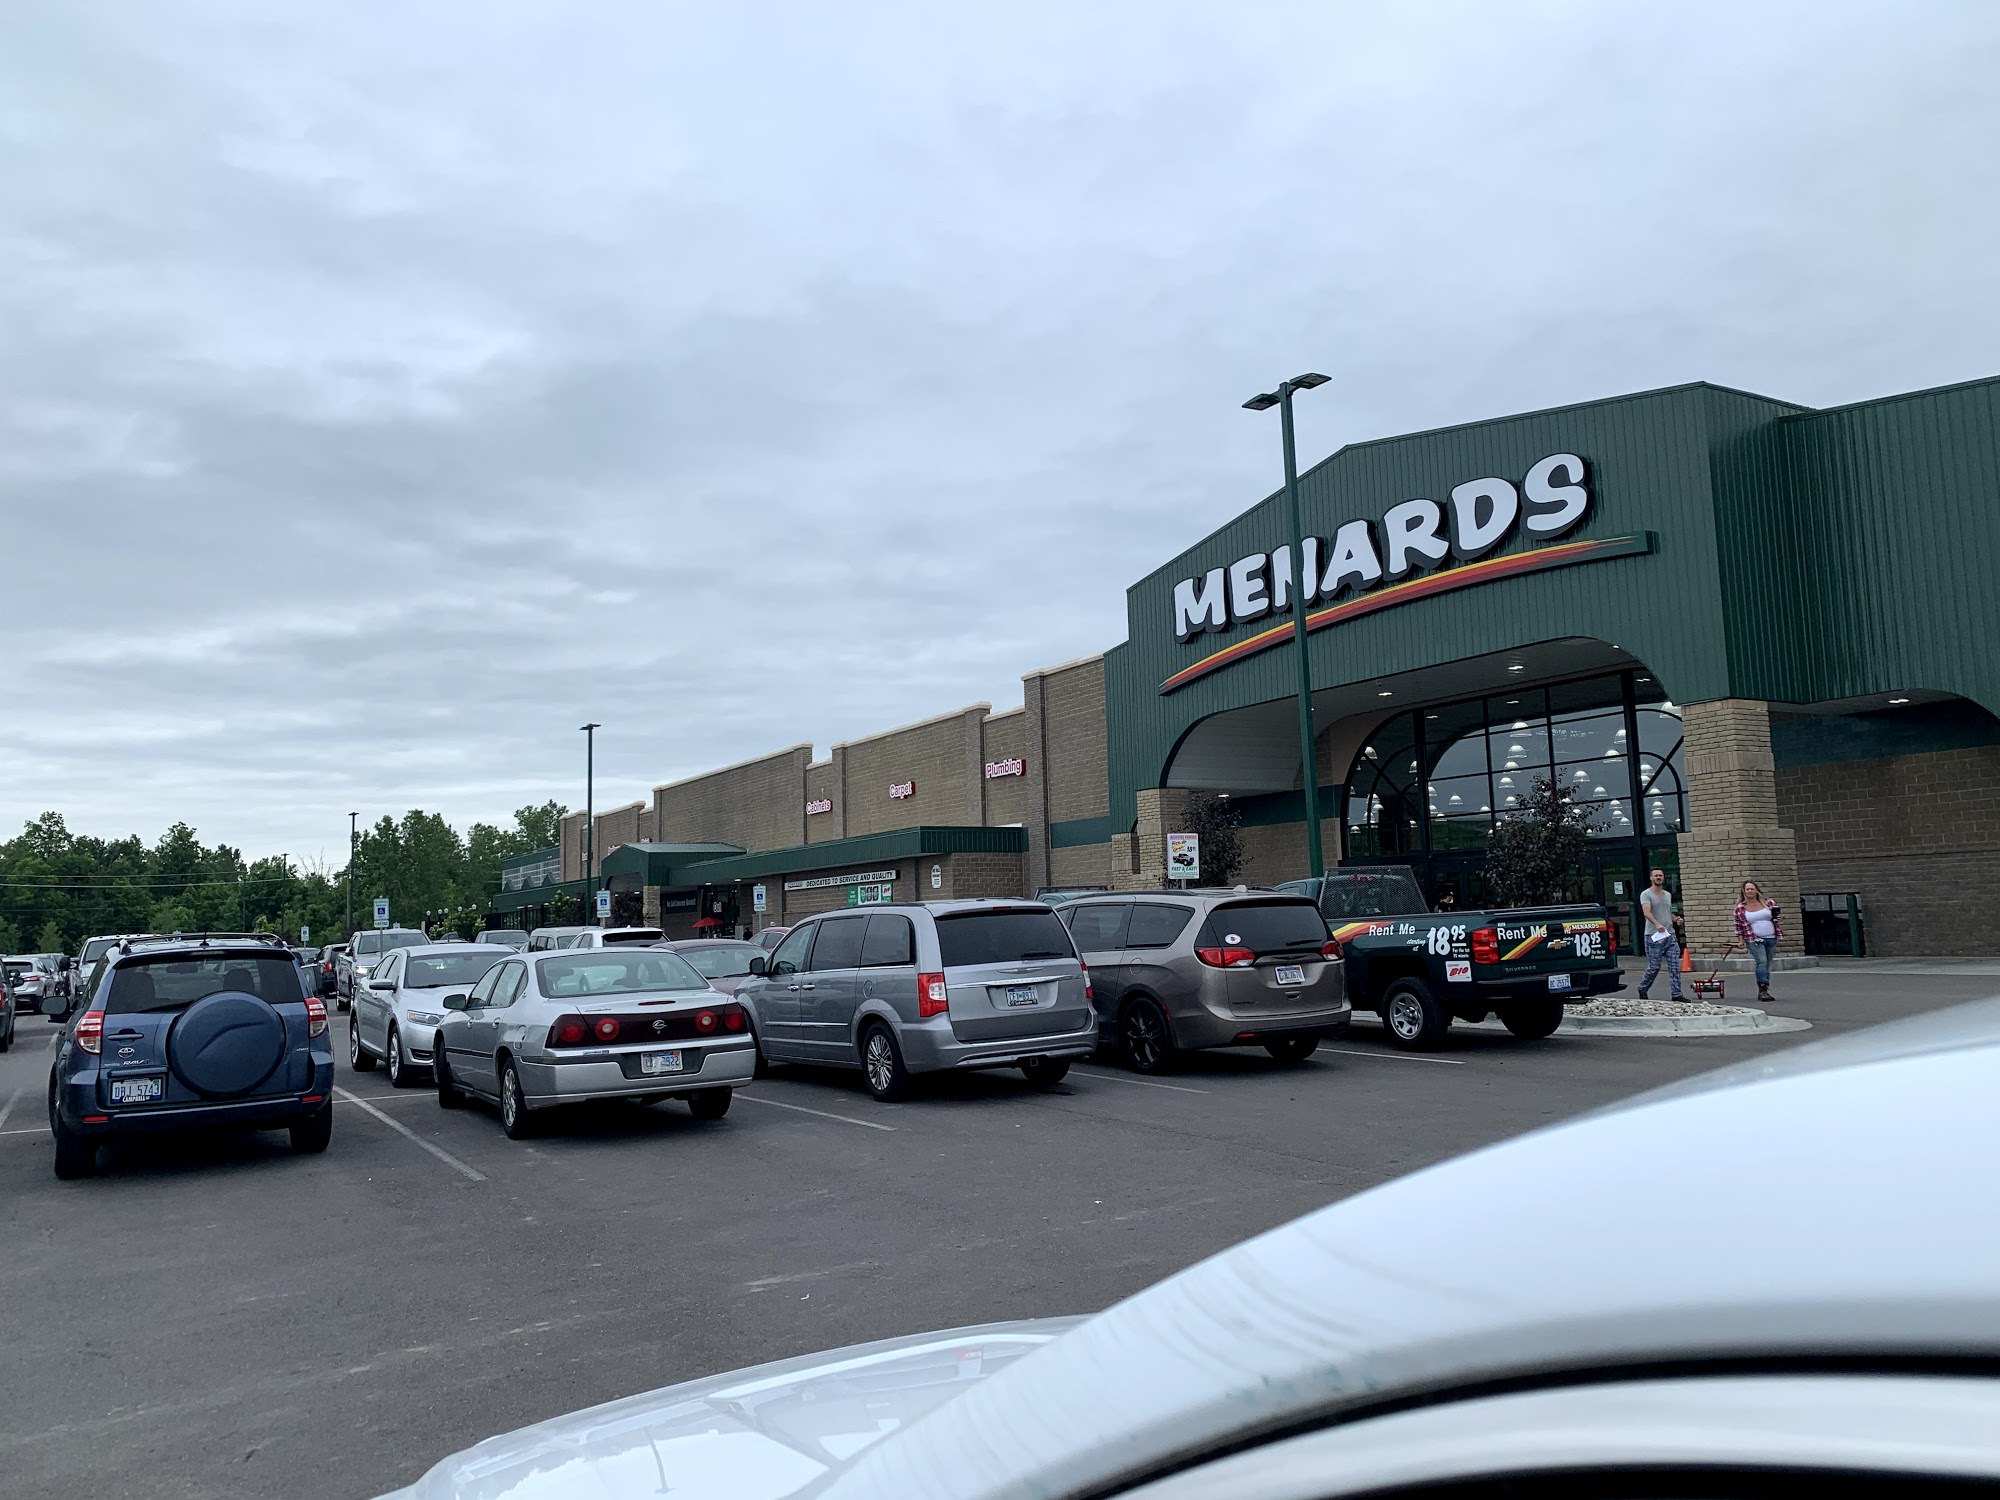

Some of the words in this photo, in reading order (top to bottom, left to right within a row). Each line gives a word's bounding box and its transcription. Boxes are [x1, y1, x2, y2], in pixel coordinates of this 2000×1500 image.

[1172, 452, 1590, 640] MENARDS
[985, 759, 1023, 779] Plumbing
[889, 782, 913, 799] Carpet
[806, 877, 831, 887] DEDICATED
[831, 876, 839, 884] TO
[839, 874, 860, 884] SERVICE
[860, 873, 871, 881] AND
[871, 871, 894, 880] QUALITY
[1369, 924, 1395, 937] Rent
[1398, 923, 1416, 935] Me
[1497, 926, 1526, 940] Rent
[1530, 925, 1548, 938] Me
[1426, 926, 1451, 956] 18
[1450, 925, 1467, 941] 95
[1573, 933, 1592, 957] 18
[1590, 931, 1602, 945] 95
